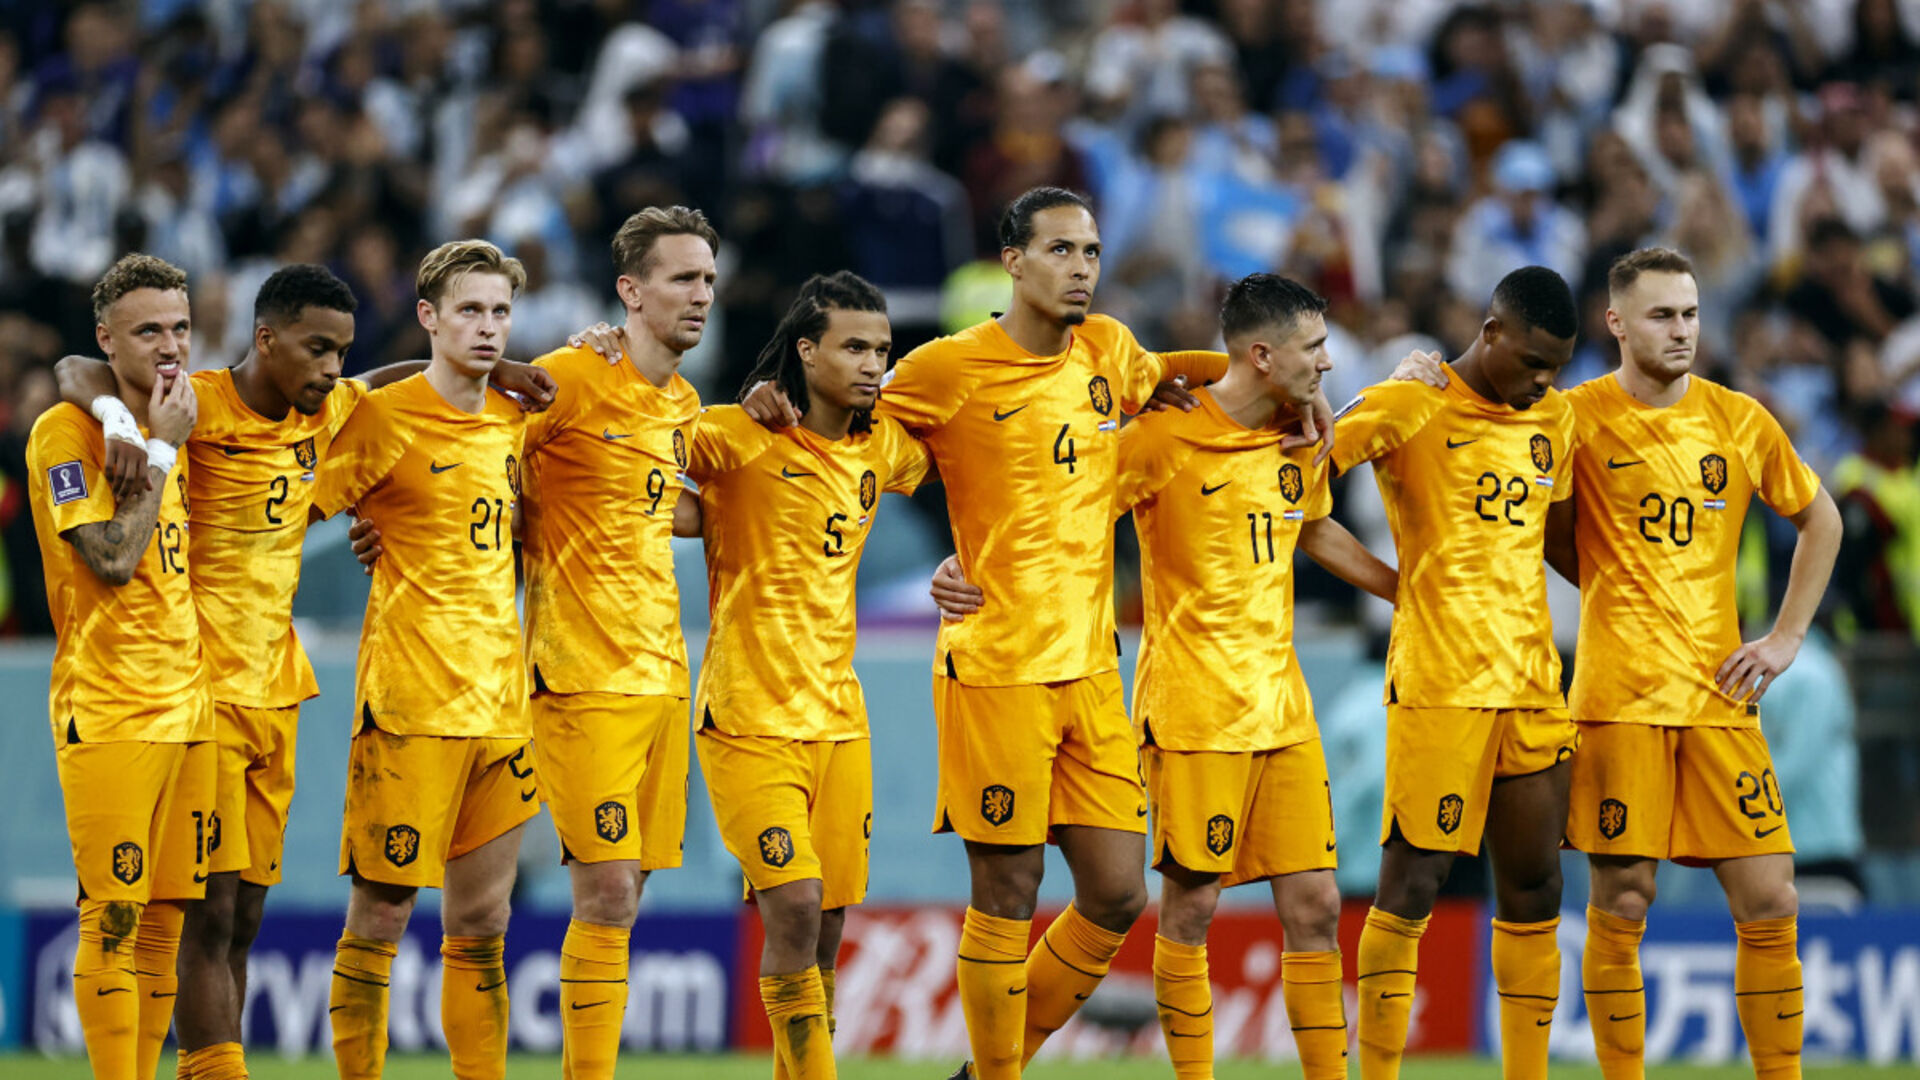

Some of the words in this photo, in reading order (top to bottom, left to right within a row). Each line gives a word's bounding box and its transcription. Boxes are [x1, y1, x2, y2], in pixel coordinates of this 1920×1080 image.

[1053, 423, 1077, 474] 4
[266, 475, 288, 524] 2
[645, 467, 665, 516] 9
[1474, 471, 1529, 526] 22
[470, 496, 503, 551] 21
[823, 512, 847, 557] 5
[1247, 511, 1275, 564] 11
[1639, 492, 1695, 547] 20
[155, 521, 185, 574] 12
[1736, 767, 1783, 819] 20
